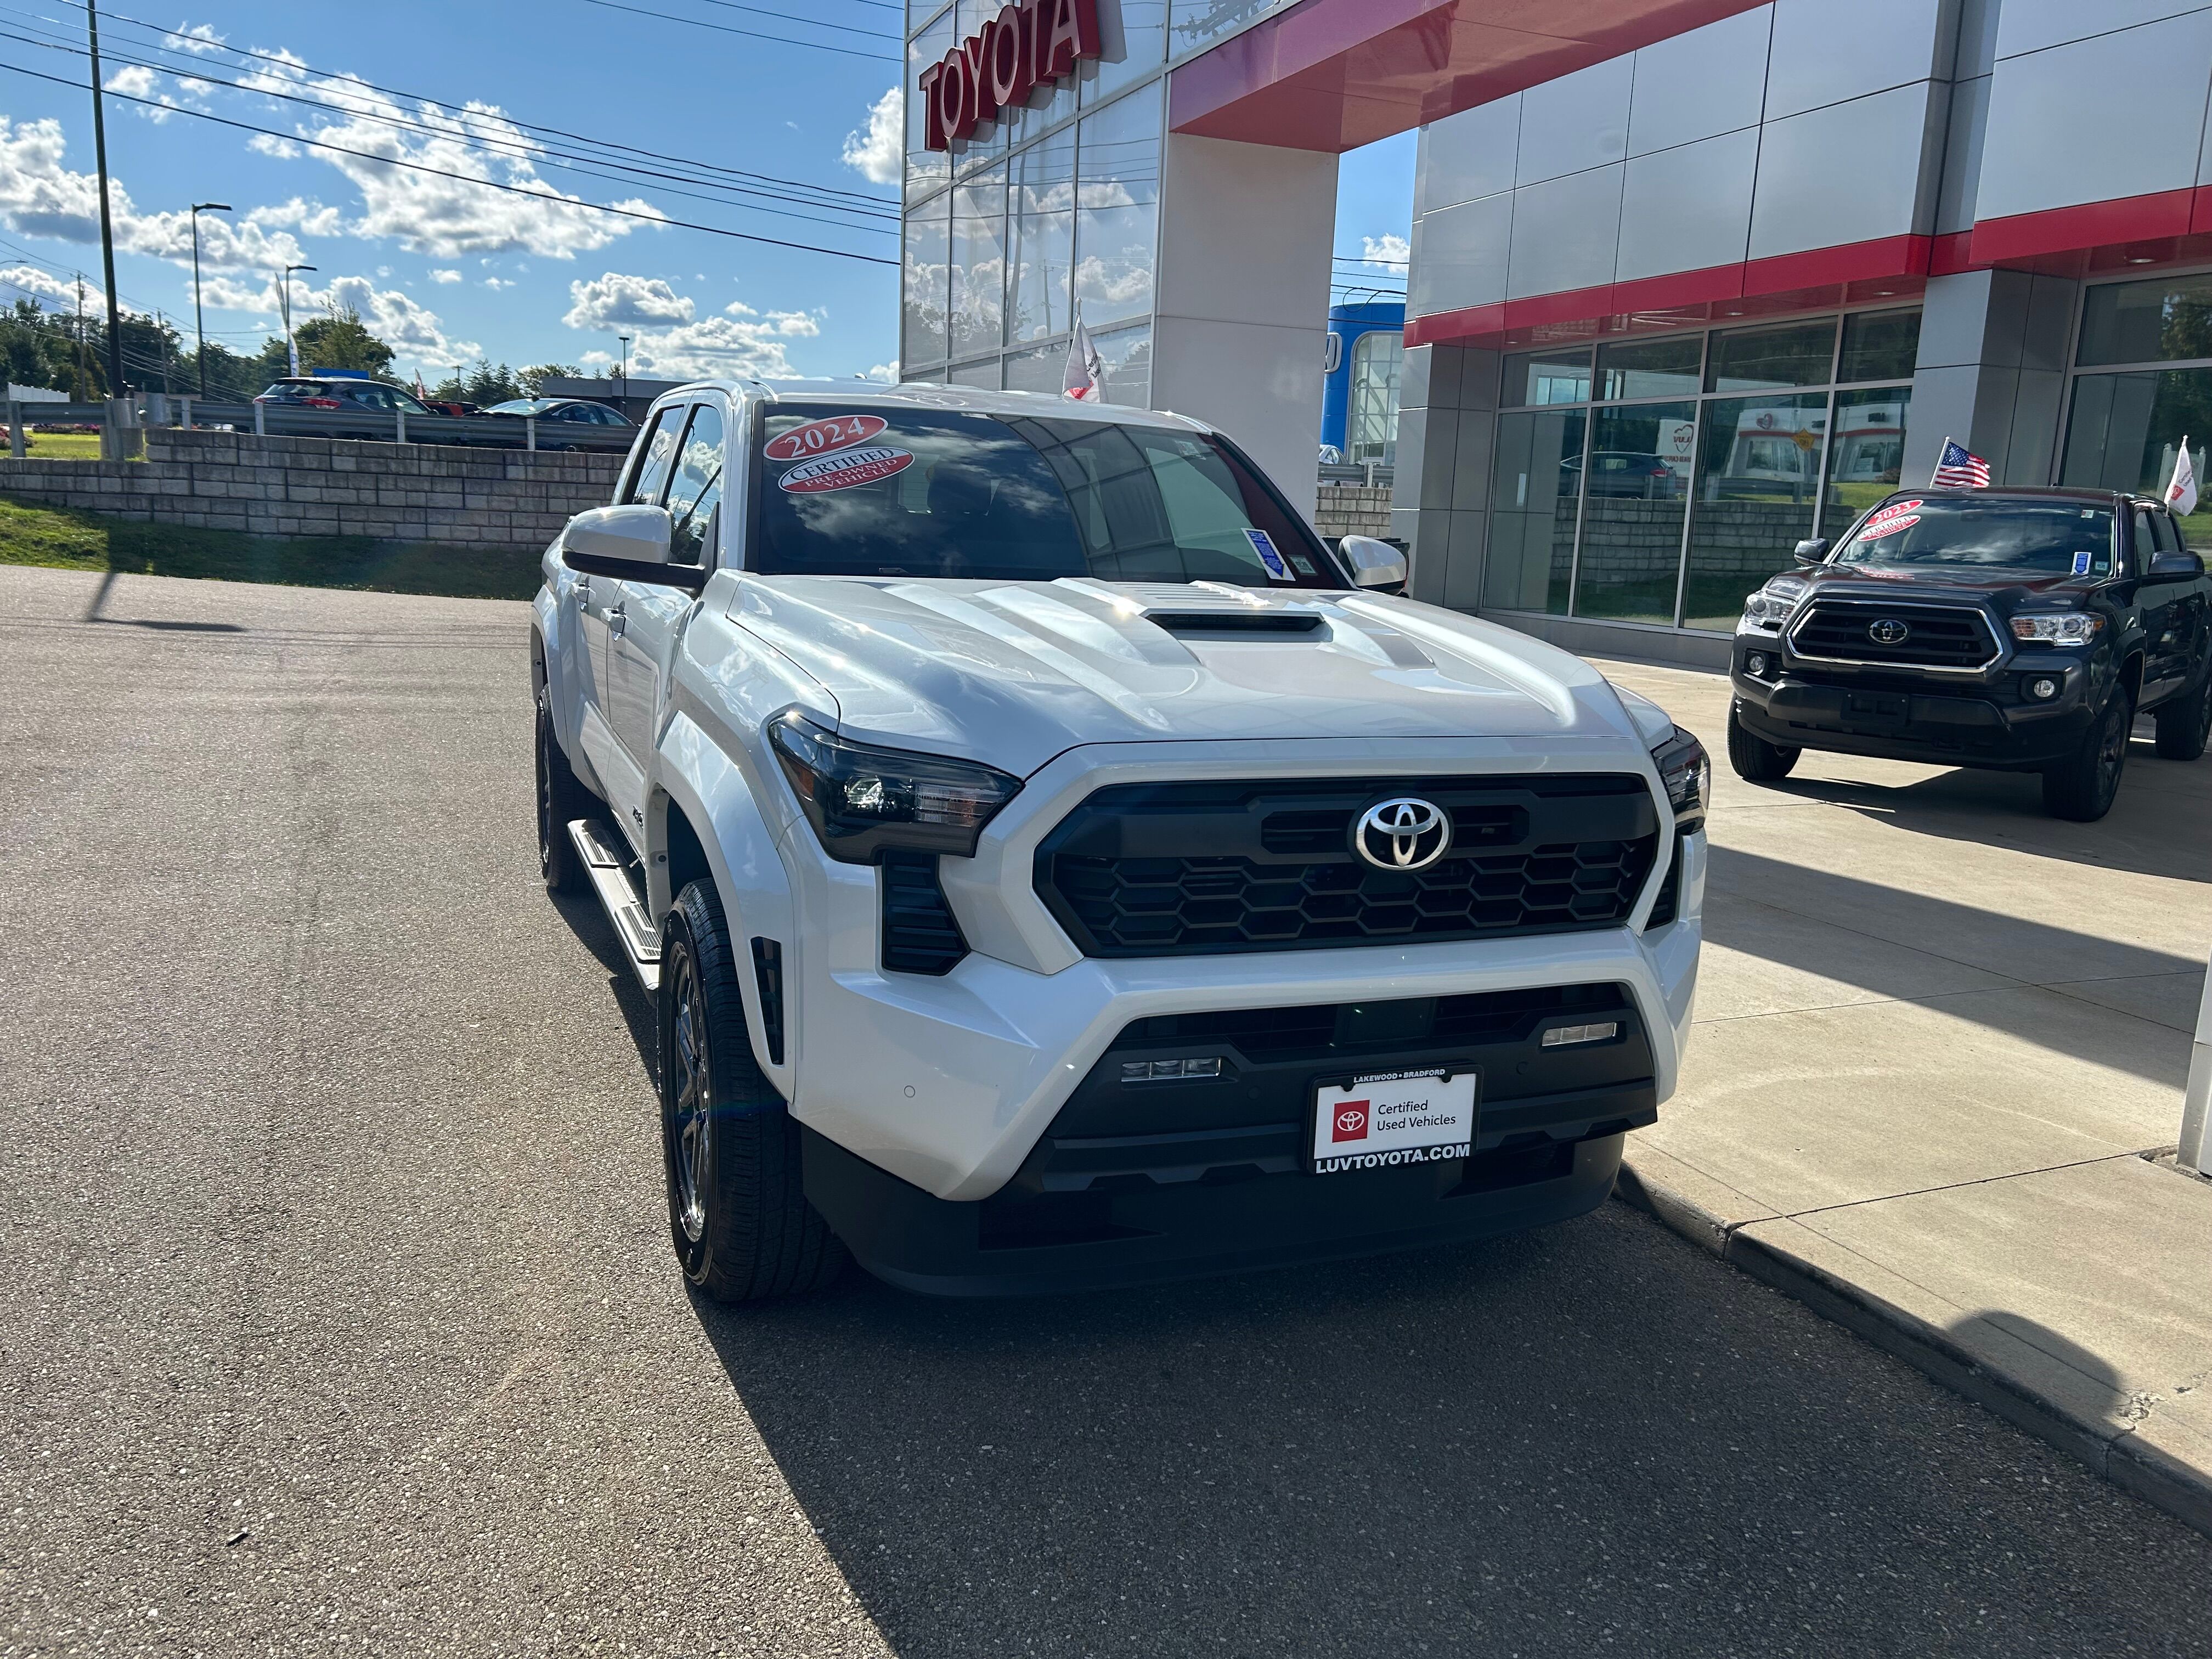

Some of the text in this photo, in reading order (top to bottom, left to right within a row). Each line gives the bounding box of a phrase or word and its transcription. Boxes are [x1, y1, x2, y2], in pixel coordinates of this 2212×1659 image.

[919, 0, 1100, 152] TOYOTA
[785, 417, 865, 458] 2024
[789, 448, 895, 481] CERTIFIED
[805, 459, 898, 487] PRE-OWNED
[823, 467, 891, 488] VEHICLE
[1874, 503, 1911, 524] 2023
[1353, 1069, 1445, 1083] LAKEWOOD BRADFORD
[1378, 1099, 1428, 1115] Certified
[1377, 1114, 1456, 1131] Used Vehicles
[1316, 1144, 1470, 1173] LUVTOYOTA.COM
